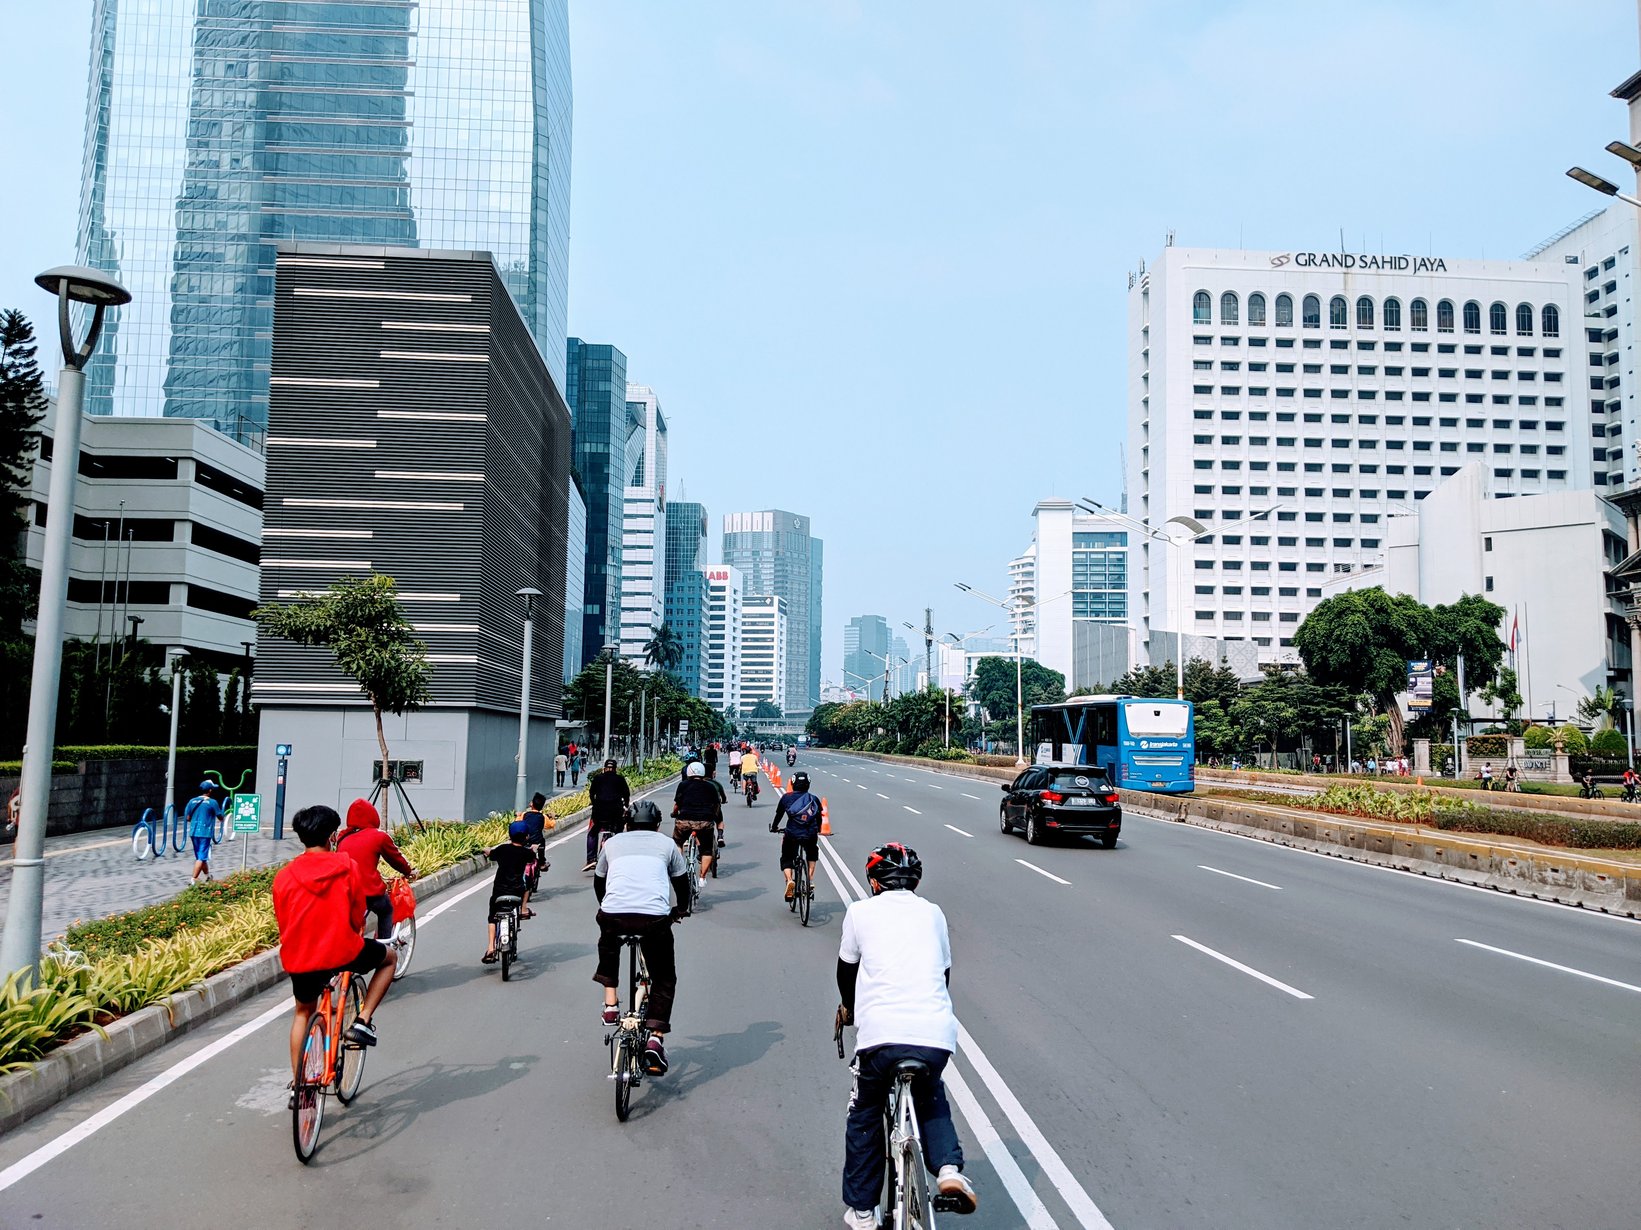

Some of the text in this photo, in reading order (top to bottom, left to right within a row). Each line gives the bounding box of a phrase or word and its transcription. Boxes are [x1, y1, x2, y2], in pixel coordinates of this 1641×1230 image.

[1295, 252, 1447, 275] GRAND SAHID JAYA
[708, 571, 729, 581] ABB
